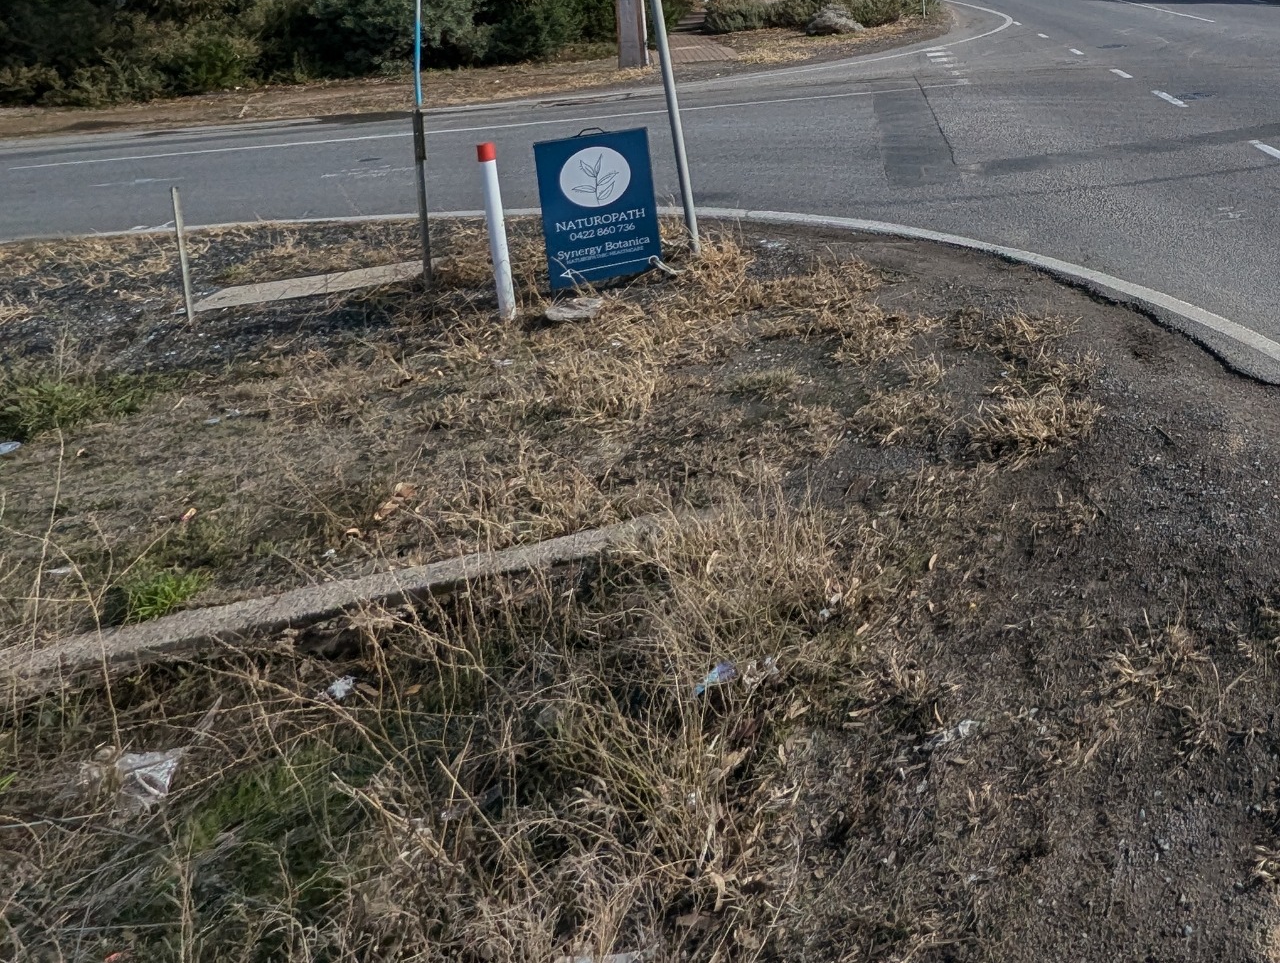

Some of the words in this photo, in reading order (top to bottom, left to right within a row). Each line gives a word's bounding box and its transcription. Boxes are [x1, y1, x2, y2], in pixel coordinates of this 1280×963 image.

[555, 208, 646, 233] NATUROPATH
[569, 229, 596, 242] 0422
[597, 226, 616, 236] 860
[616, 222, 636, 232] 736
[557, 245, 603, 261] Synergy
[605, 236, 650, 251] Botanica
